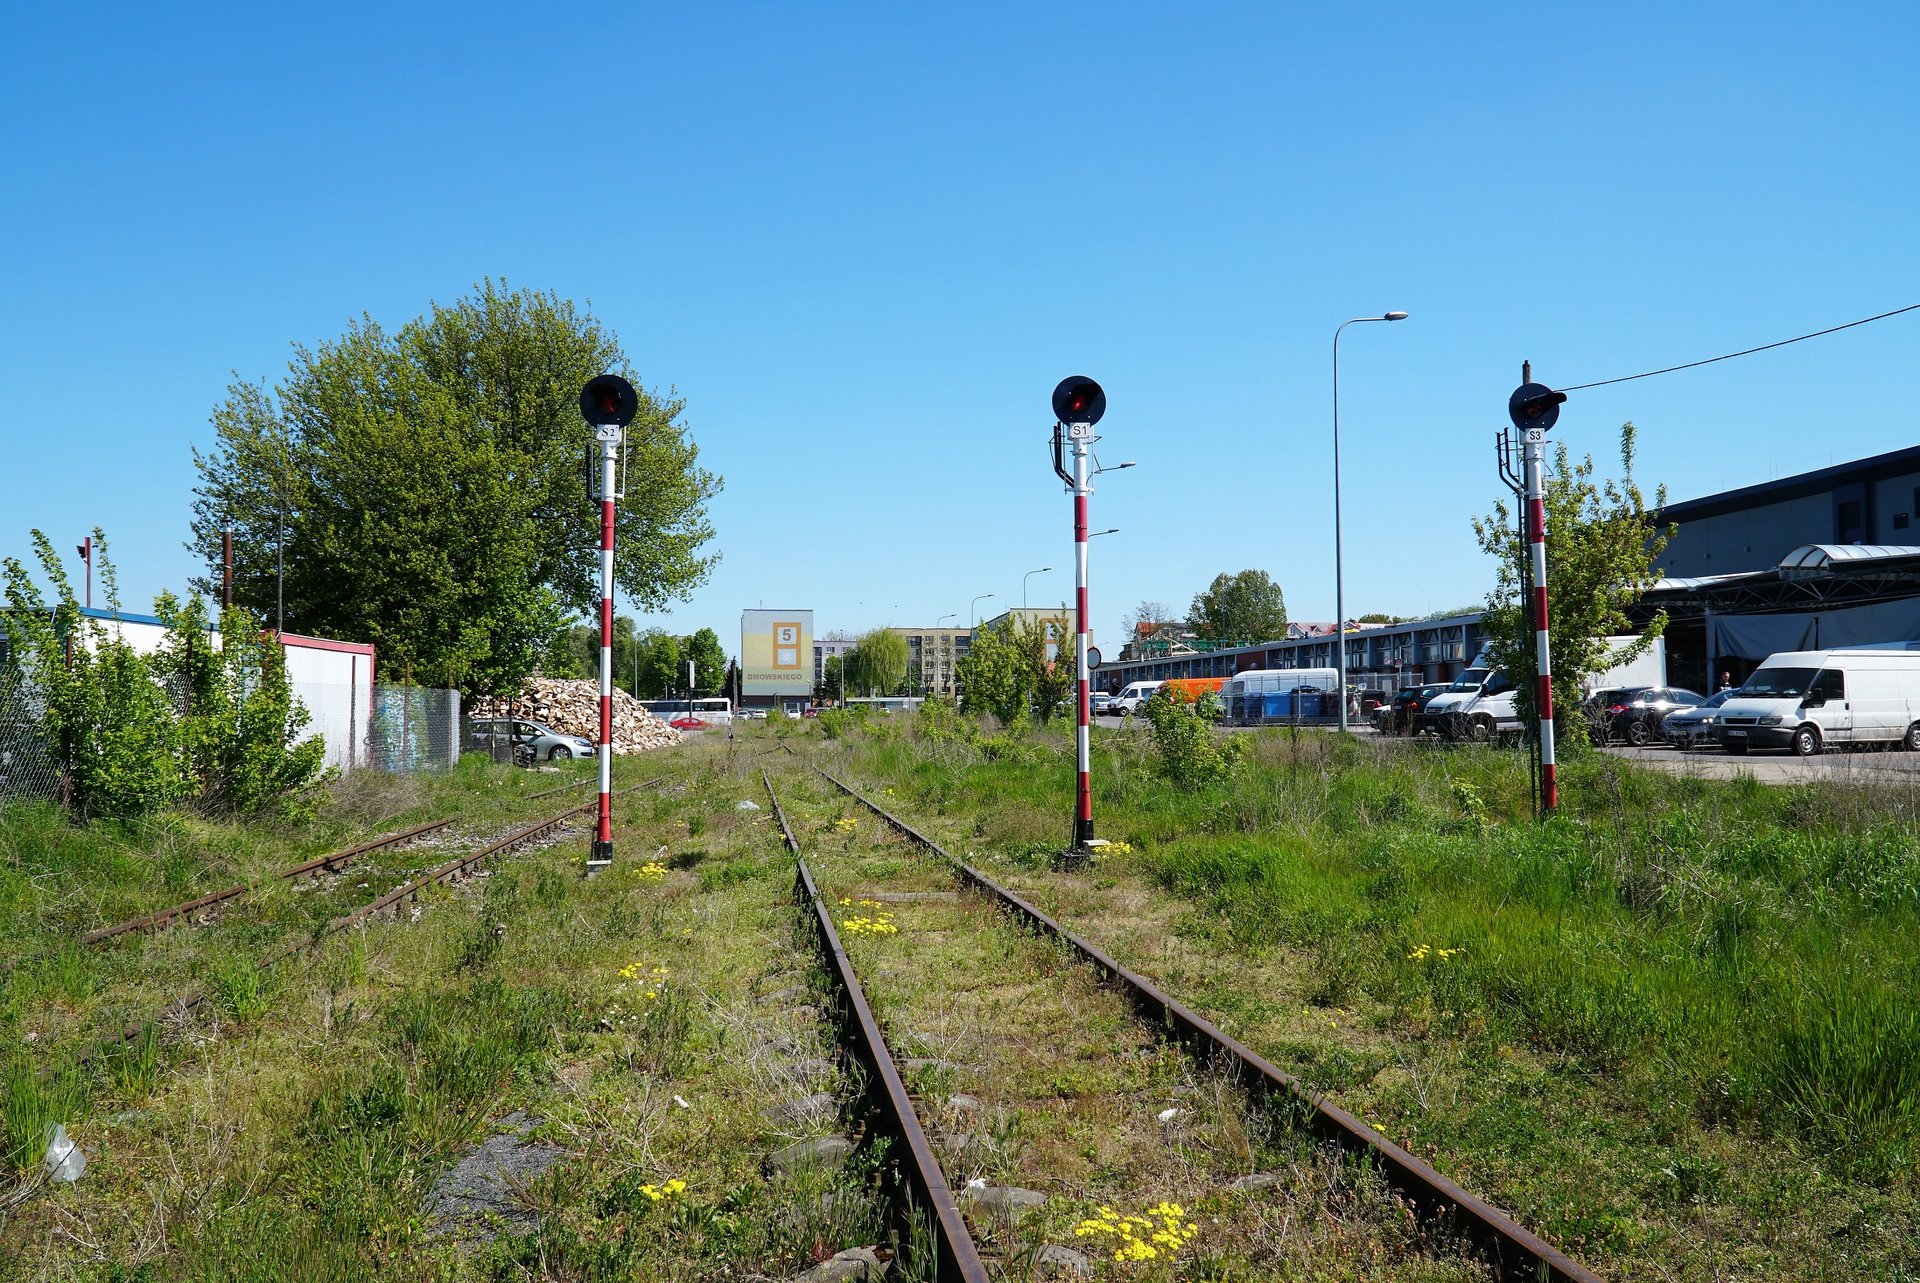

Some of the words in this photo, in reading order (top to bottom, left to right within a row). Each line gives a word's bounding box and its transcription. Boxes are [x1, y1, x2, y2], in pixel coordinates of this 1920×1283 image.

[601, 427, 615, 437] S2
[1073, 425, 1087, 435] S1
[1529, 430, 1541, 440] S3
[782, 629, 792, 641] 5
